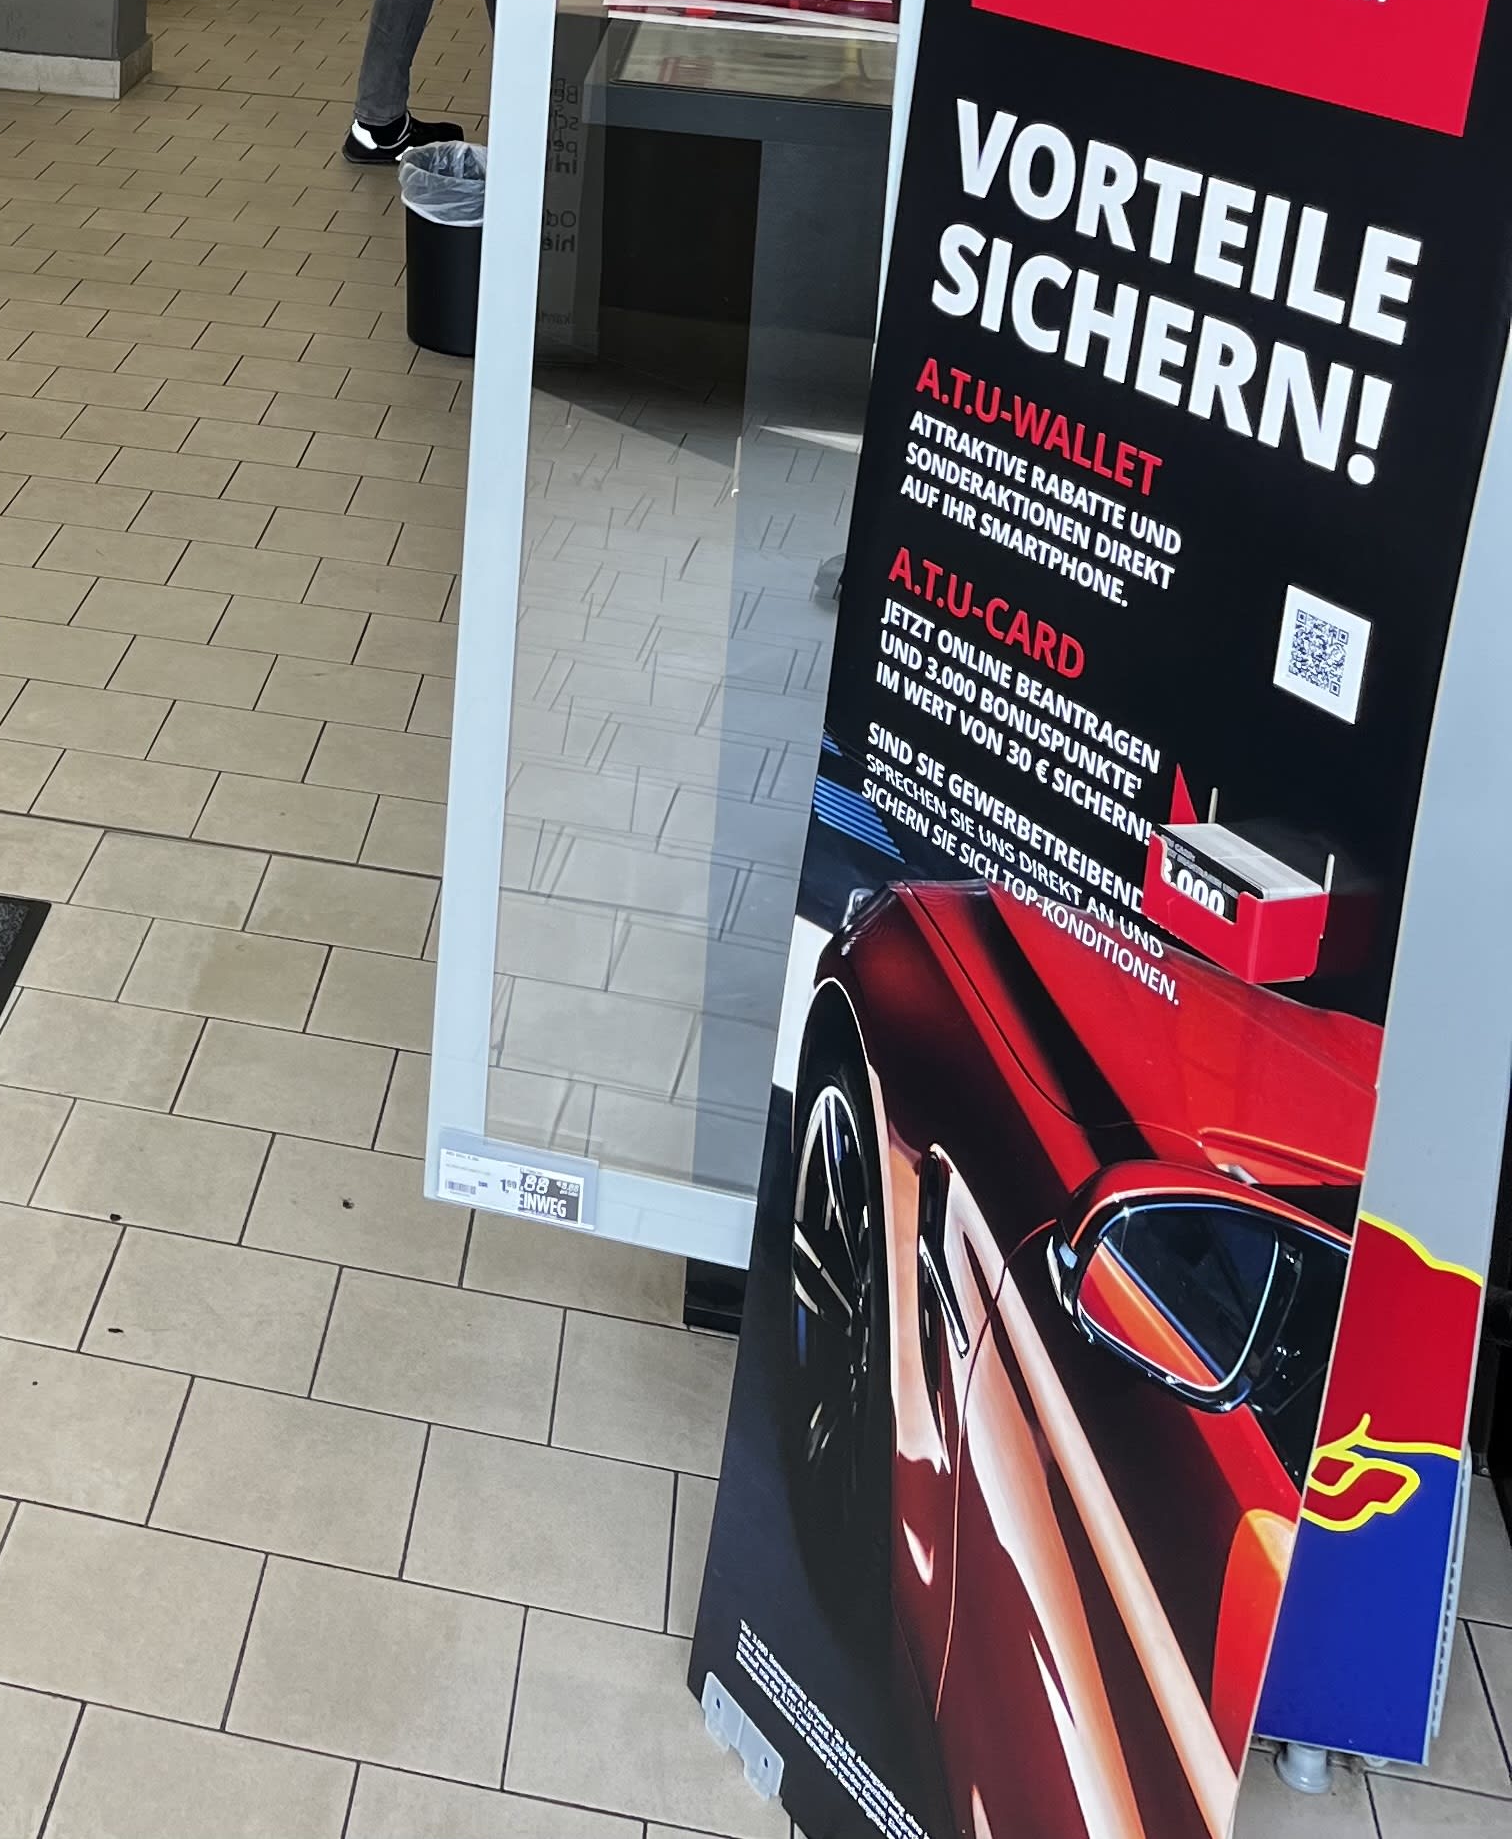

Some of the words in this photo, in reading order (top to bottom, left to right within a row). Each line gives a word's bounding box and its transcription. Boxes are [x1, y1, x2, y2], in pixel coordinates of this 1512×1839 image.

[957, 97, 1423, 346] VORTEILE
[915, 357, 1163, 496] A.T.U-WALLET
[931, 222, 1393, 486] SICHERN!
[900, 475, 941, 509] AUF
[943, 493, 977, 530] IHR
[979, 512, 1128, 608] SMARTPHONE.
[906, 442, 1090, 550] SONDERAKTIONEN
[1095, 531, 1176, 590] DIREKT
[909, 411, 1028, 484] ATTRAKTIVE
[1030, 466, 1127, 529] RABATTE
[1129, 511, 1182, 555] UND
[880, 630, 923, 670] UND
[925, 656, 976, 703] 3.000
[880, 598, 936, 643] JETZT
[938, 629, 1012, 689] ONLINE
[1016, 671, 1161, 774] BEANTRAGEN
[888, 546, 1085, 679] A.T.U-CARD
[868, 721, 914, 765] SIND
[917, 752, 946, 788] SIE
[948, 774, 1143, 914] GEWERBETREIBEND
[876, 662, 899, 694] IM
[904, 676, 957, 726] WERT
[960, 709, 1004, 756] VON
[1007, 740, 1032, 772] 30
[1036, 758, 1049, 784] €
[1052, 768, 1153, 846] SICHERN!
[862, 778, 930, 837] SICHERN
[932, 824, 956, 857] SIE
[960, 840, 1000, 883] SICH
[1002, 868, 1179, 1006] TOP-KONDITIONEN.
[866, 754, 947, 819] SPRECHEN
[950, 807, 975, 838] SIE
[979, 825, 1015, 863] UNS
[1019, 850, 1083, 906] DIREKT
[1087, 898, 1115, 929] AN
[1119, 914, 1164, 959] UND
